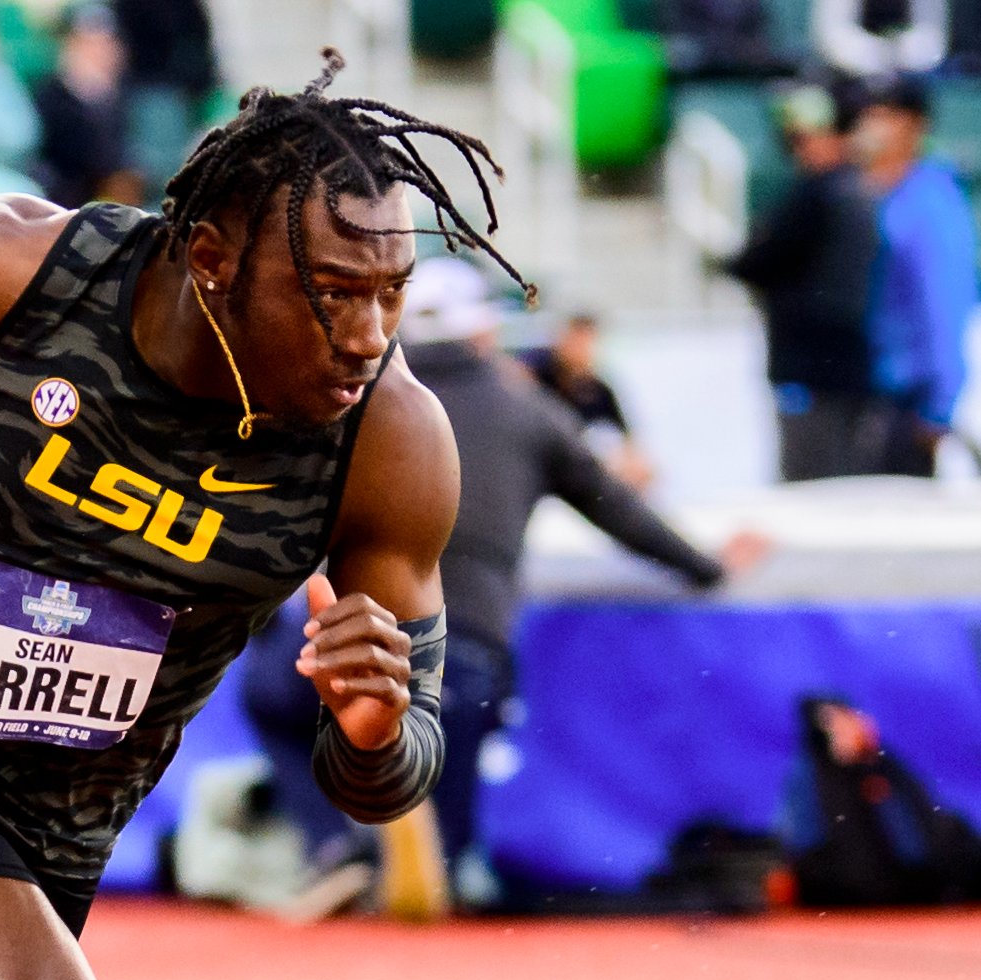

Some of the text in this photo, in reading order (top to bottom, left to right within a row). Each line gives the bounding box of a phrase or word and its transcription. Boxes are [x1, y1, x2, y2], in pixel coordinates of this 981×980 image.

[34, 380, 77, 424] SEC
[24, 433, 224, 563] LSU
[15, 637, 74, 664] SEAN
[2, 722, 28, 733] FIELD
[43, 724, 70, 738] JUNE
